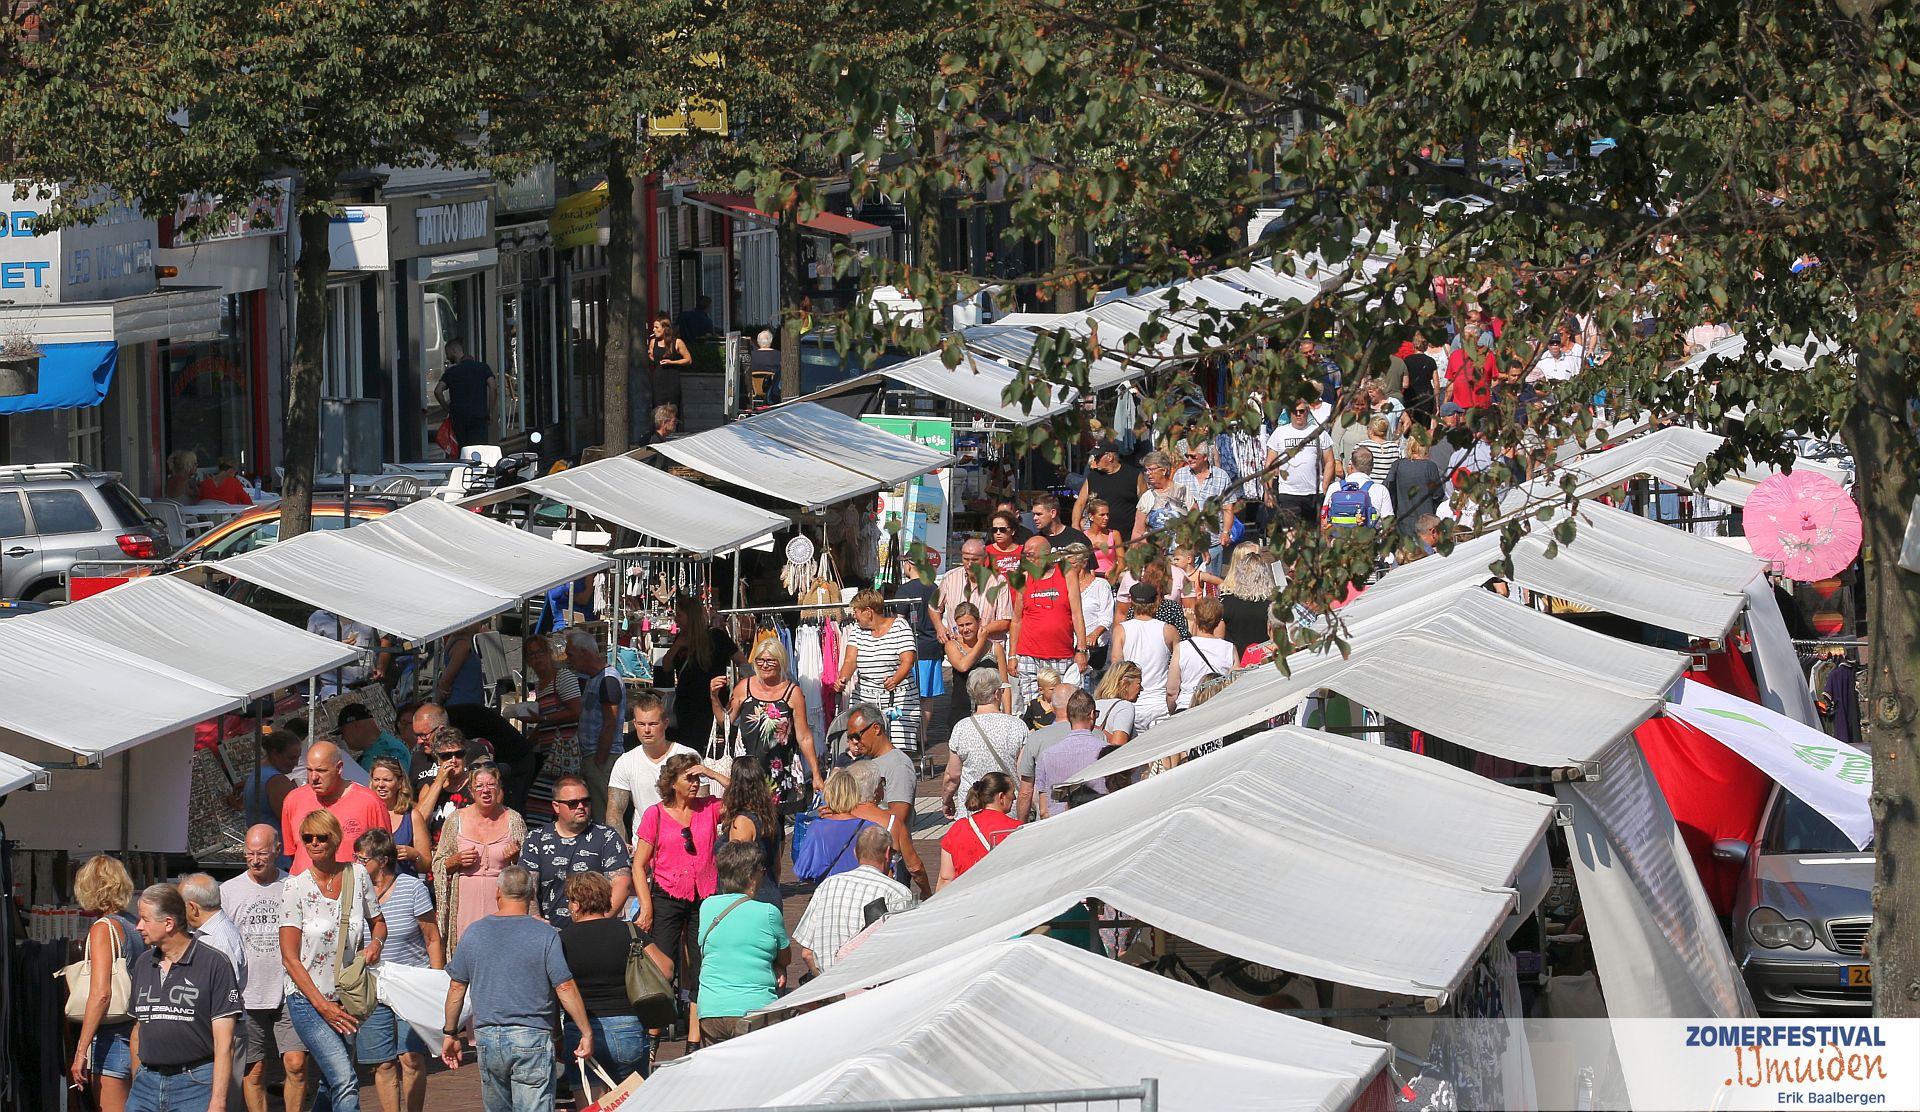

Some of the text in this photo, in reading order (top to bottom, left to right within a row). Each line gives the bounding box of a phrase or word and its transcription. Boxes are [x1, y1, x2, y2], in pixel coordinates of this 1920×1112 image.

[416, 200, 488, 246] TATTOO BIRDY
[1, 261, 50, 289] ET
[1030, 591, 1060, 599] DIADORA
[151, 1005, 195, 1015] ZEALAND
